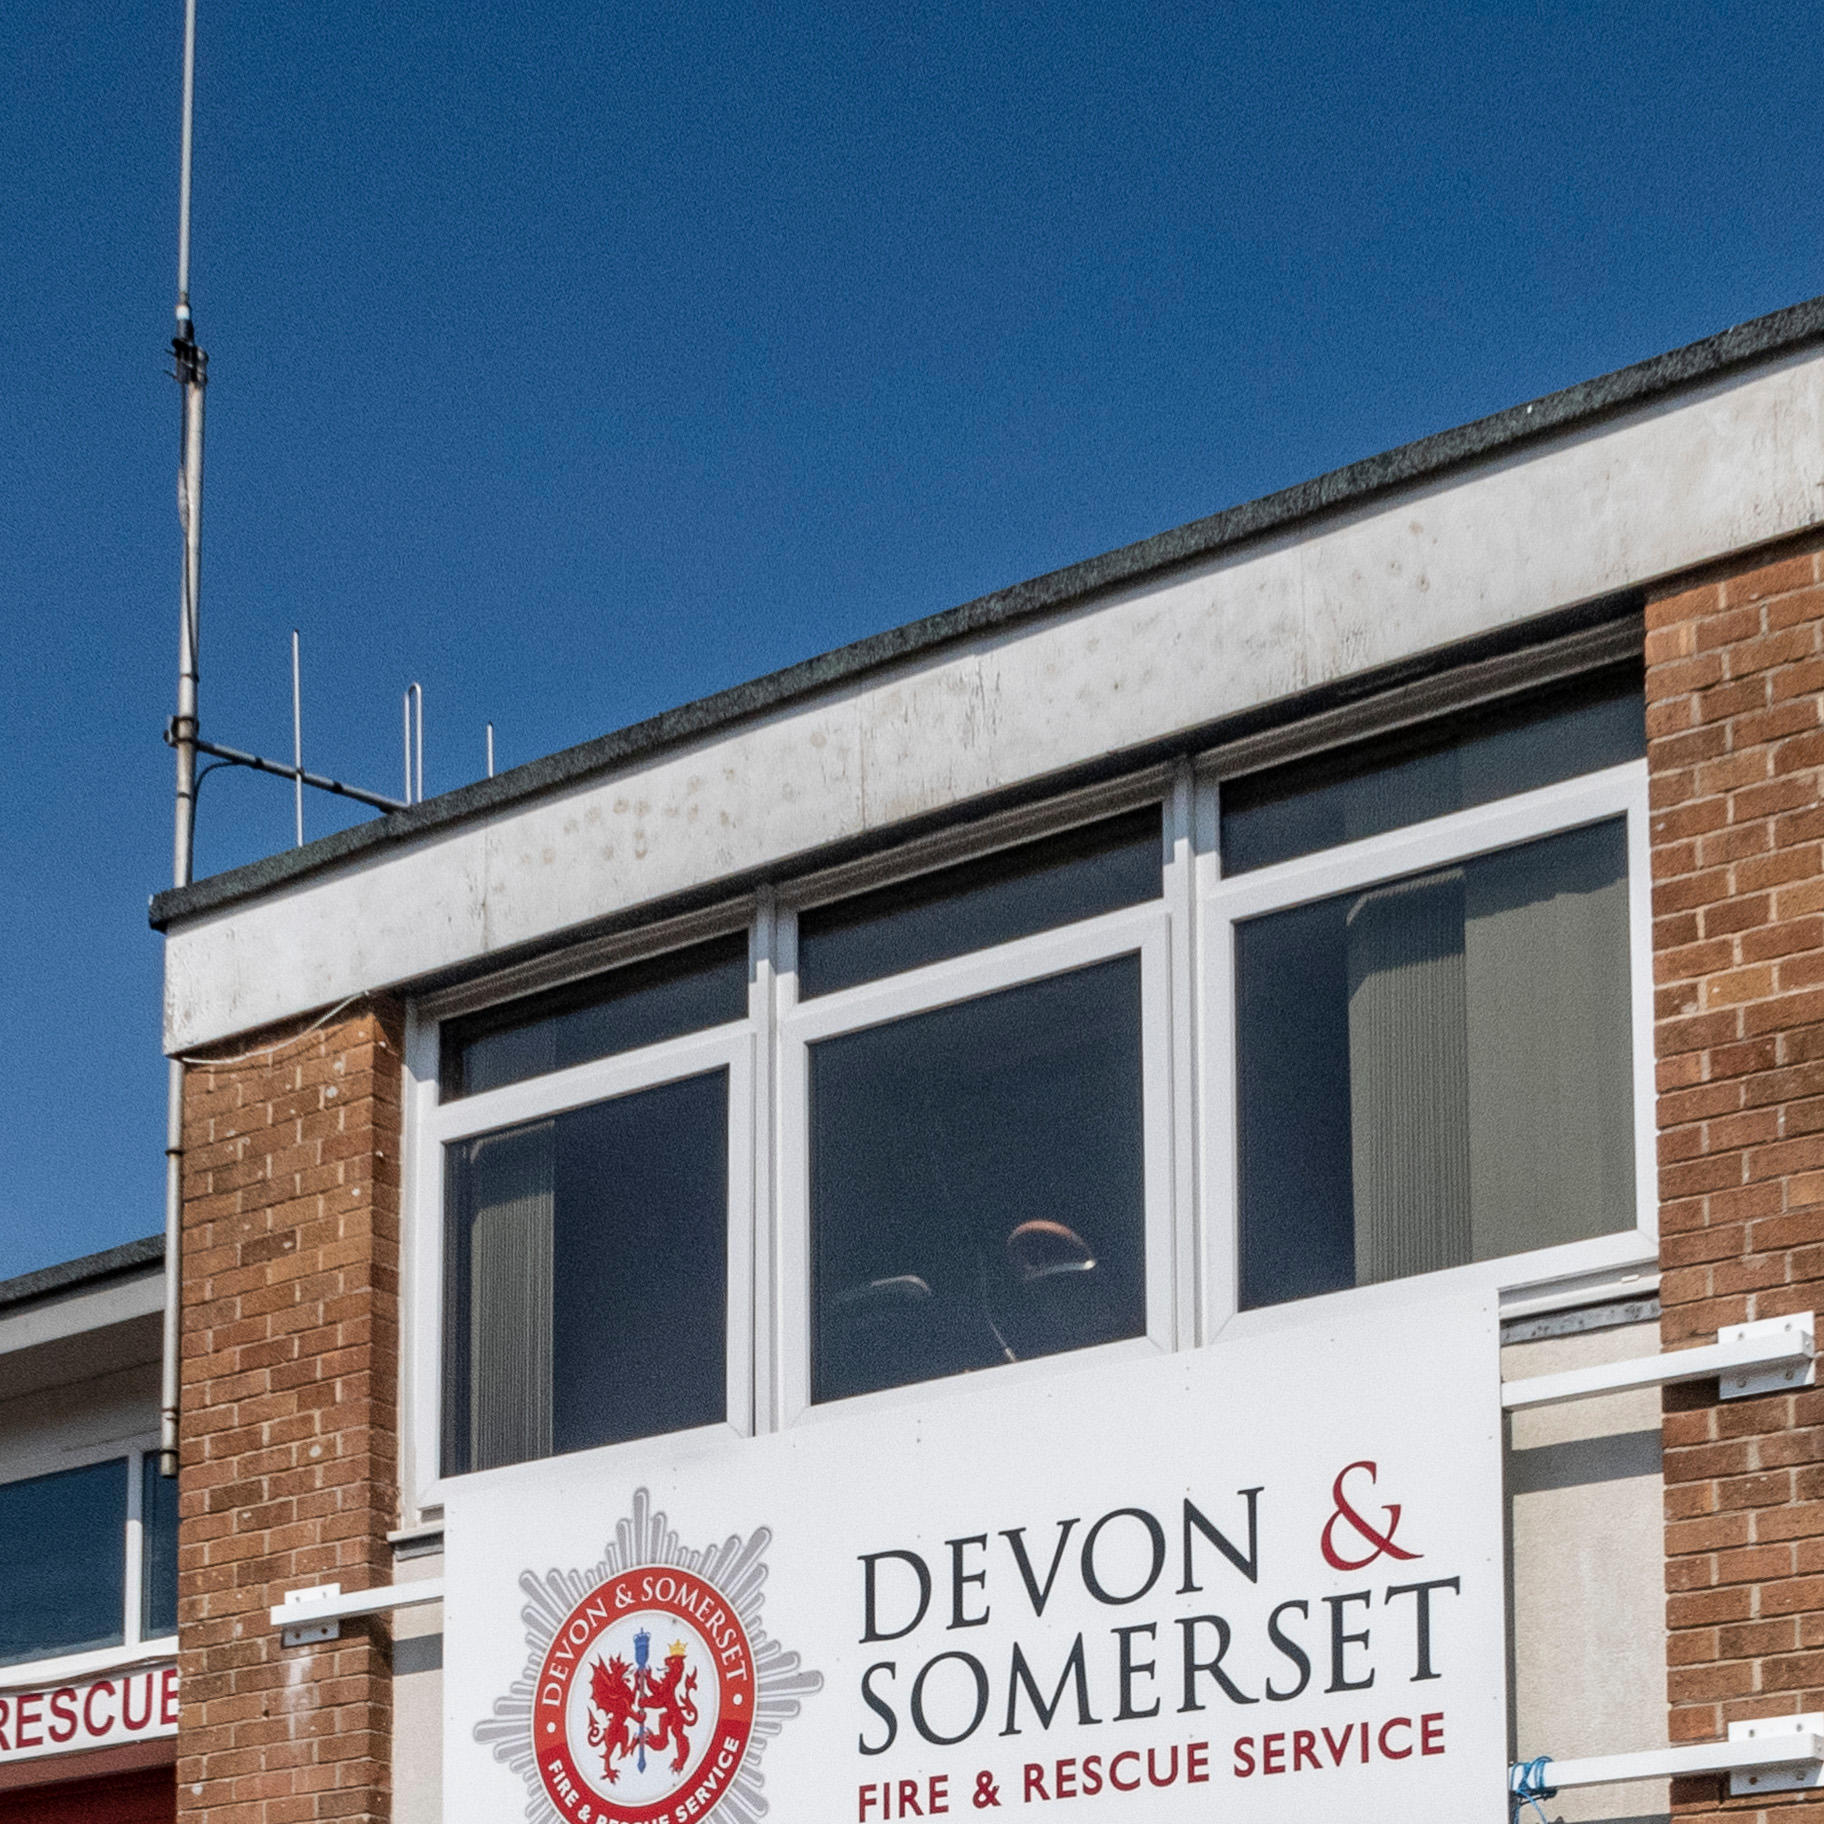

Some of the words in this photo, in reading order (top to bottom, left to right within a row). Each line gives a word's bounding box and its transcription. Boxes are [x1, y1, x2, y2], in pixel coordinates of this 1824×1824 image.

[857, 1486, 1265, 1644] DEVON
[1321, 1461, 1424, 1571] &
[543, 1599, 609, 1707] DEVON
[615, 1584, 634, 1609] &
[641, 1576, 747, 1681] SOMERSET
[858, 1576, 1461, 1755] SOMERSET
[548, 1760, 580, 1808] FIRE
[577, 1804, 591, 1822] &
[675, 1736, 739, 1822] SERVICE
[859, 1775, 949, 1823] FIRE
[972, 1771, 1001, 1808] &
[1023, 1742, 1209, 1803] RESCUE
[1233, 1712, 1446, 1779] SERVICE
